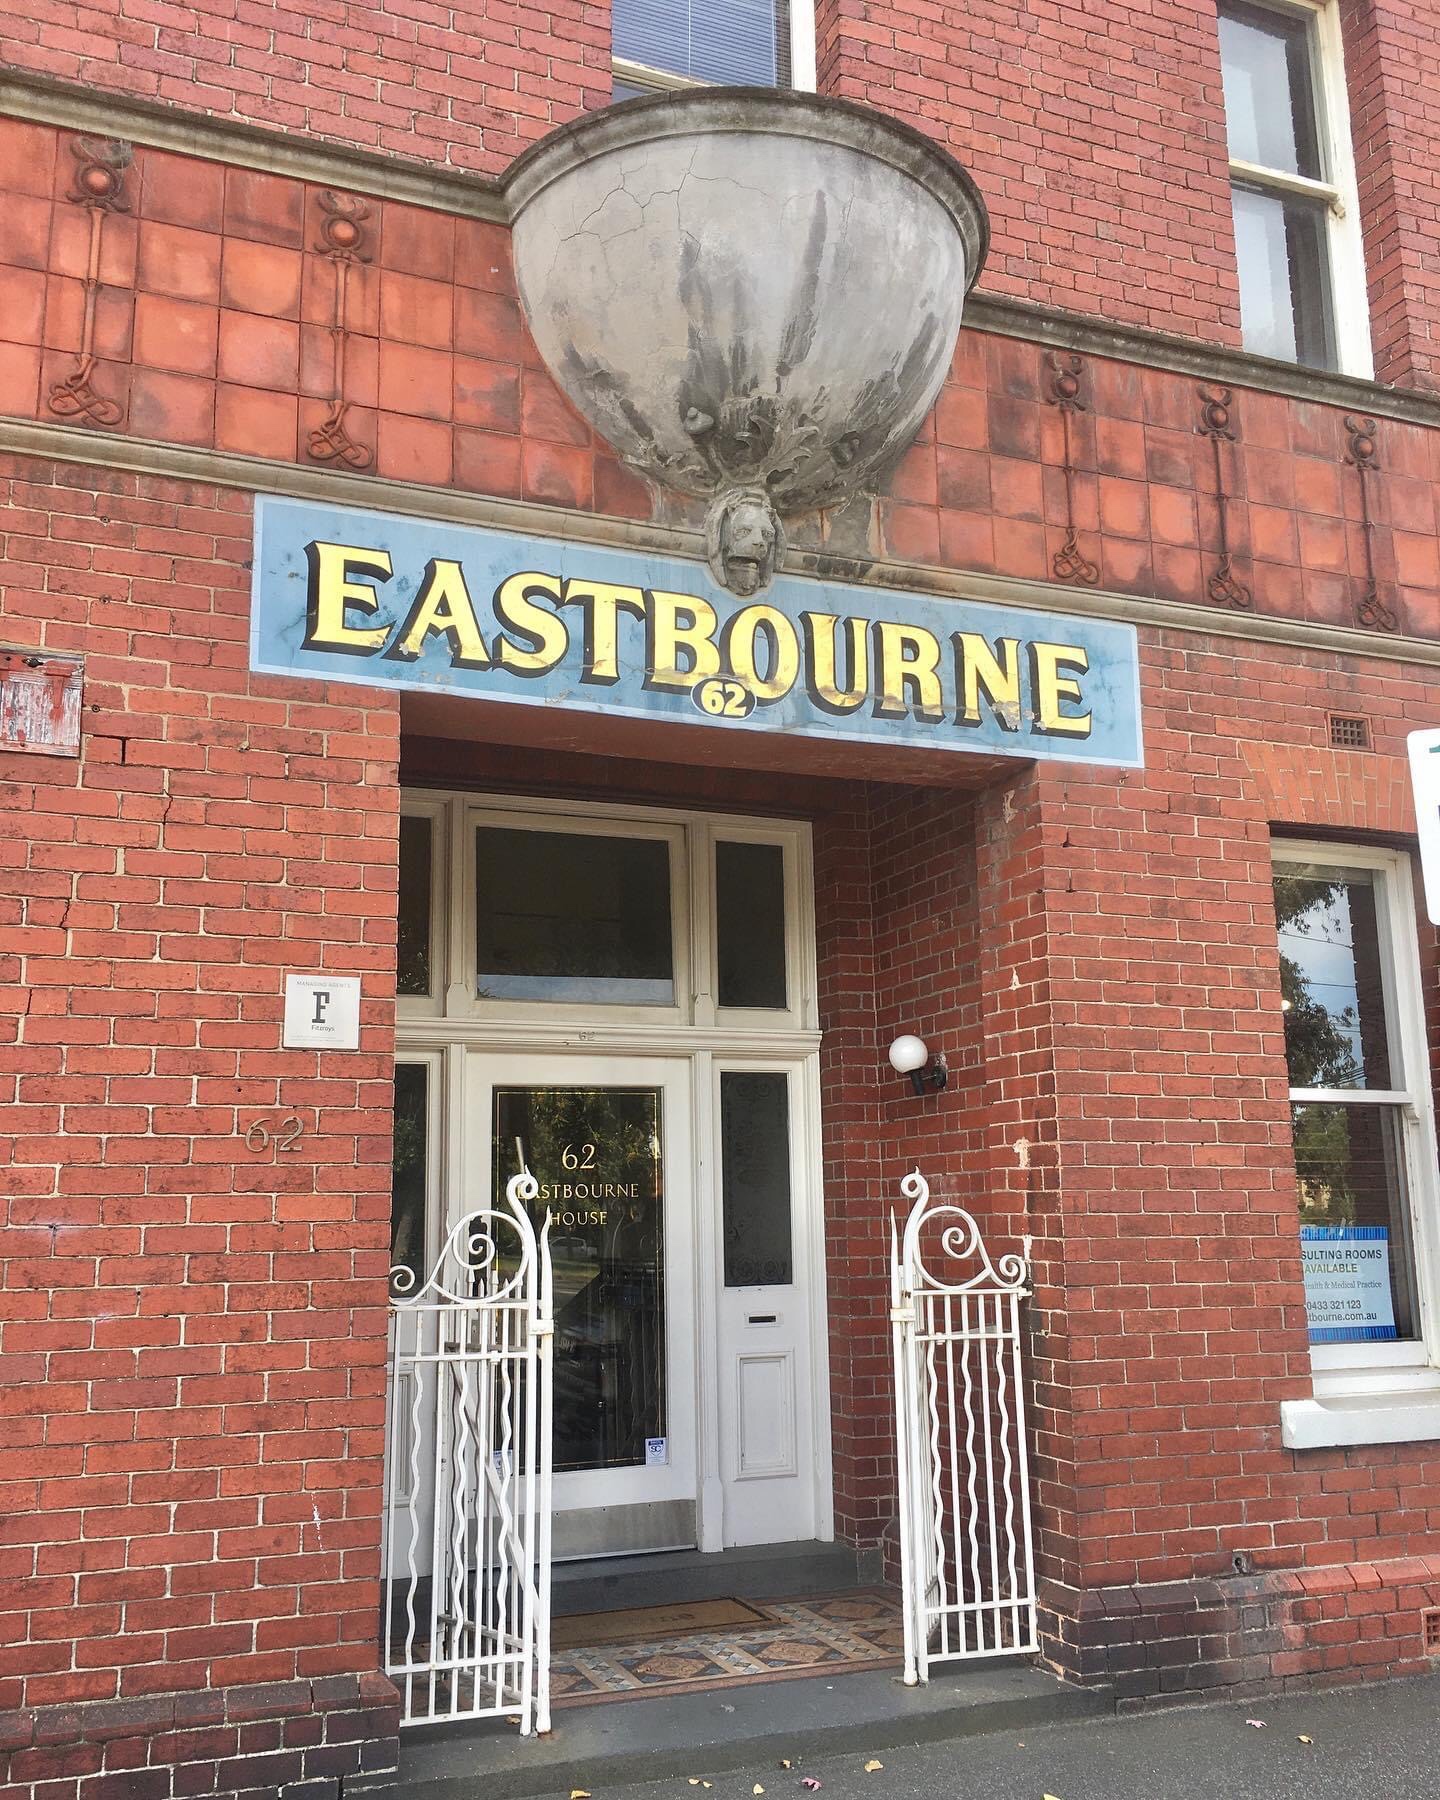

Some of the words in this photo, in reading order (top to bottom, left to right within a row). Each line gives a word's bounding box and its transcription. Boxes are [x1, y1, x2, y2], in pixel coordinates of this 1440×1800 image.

[301, 540, 1092, 740] EASTBOURNE
[700, 680, 747, 717] 62
[312, 992, 330, 1023] F
[245, 1116, 304, 1153] 62
[562, 1143, 597, 1170] 62
[517, 1183, 639, 1199] ESTBOURNE
[550, 1211, 608, 1226] HOUSE
[1345, 1249, 1382, 1260] ROOMS
[1305, 1263, 1358, 1274] AVAILABLE
[1304, 1281, 1323, 1290] ealth
[1331, 1281, 1356, 1289] Medical
[1357, 1280, 1382, 1289] Practice
[1306, 1301, 1328, 1310] 0433
[1330, 1300, 1345, 1310] 321
[1347, 1300, 1361, 1309] 123
